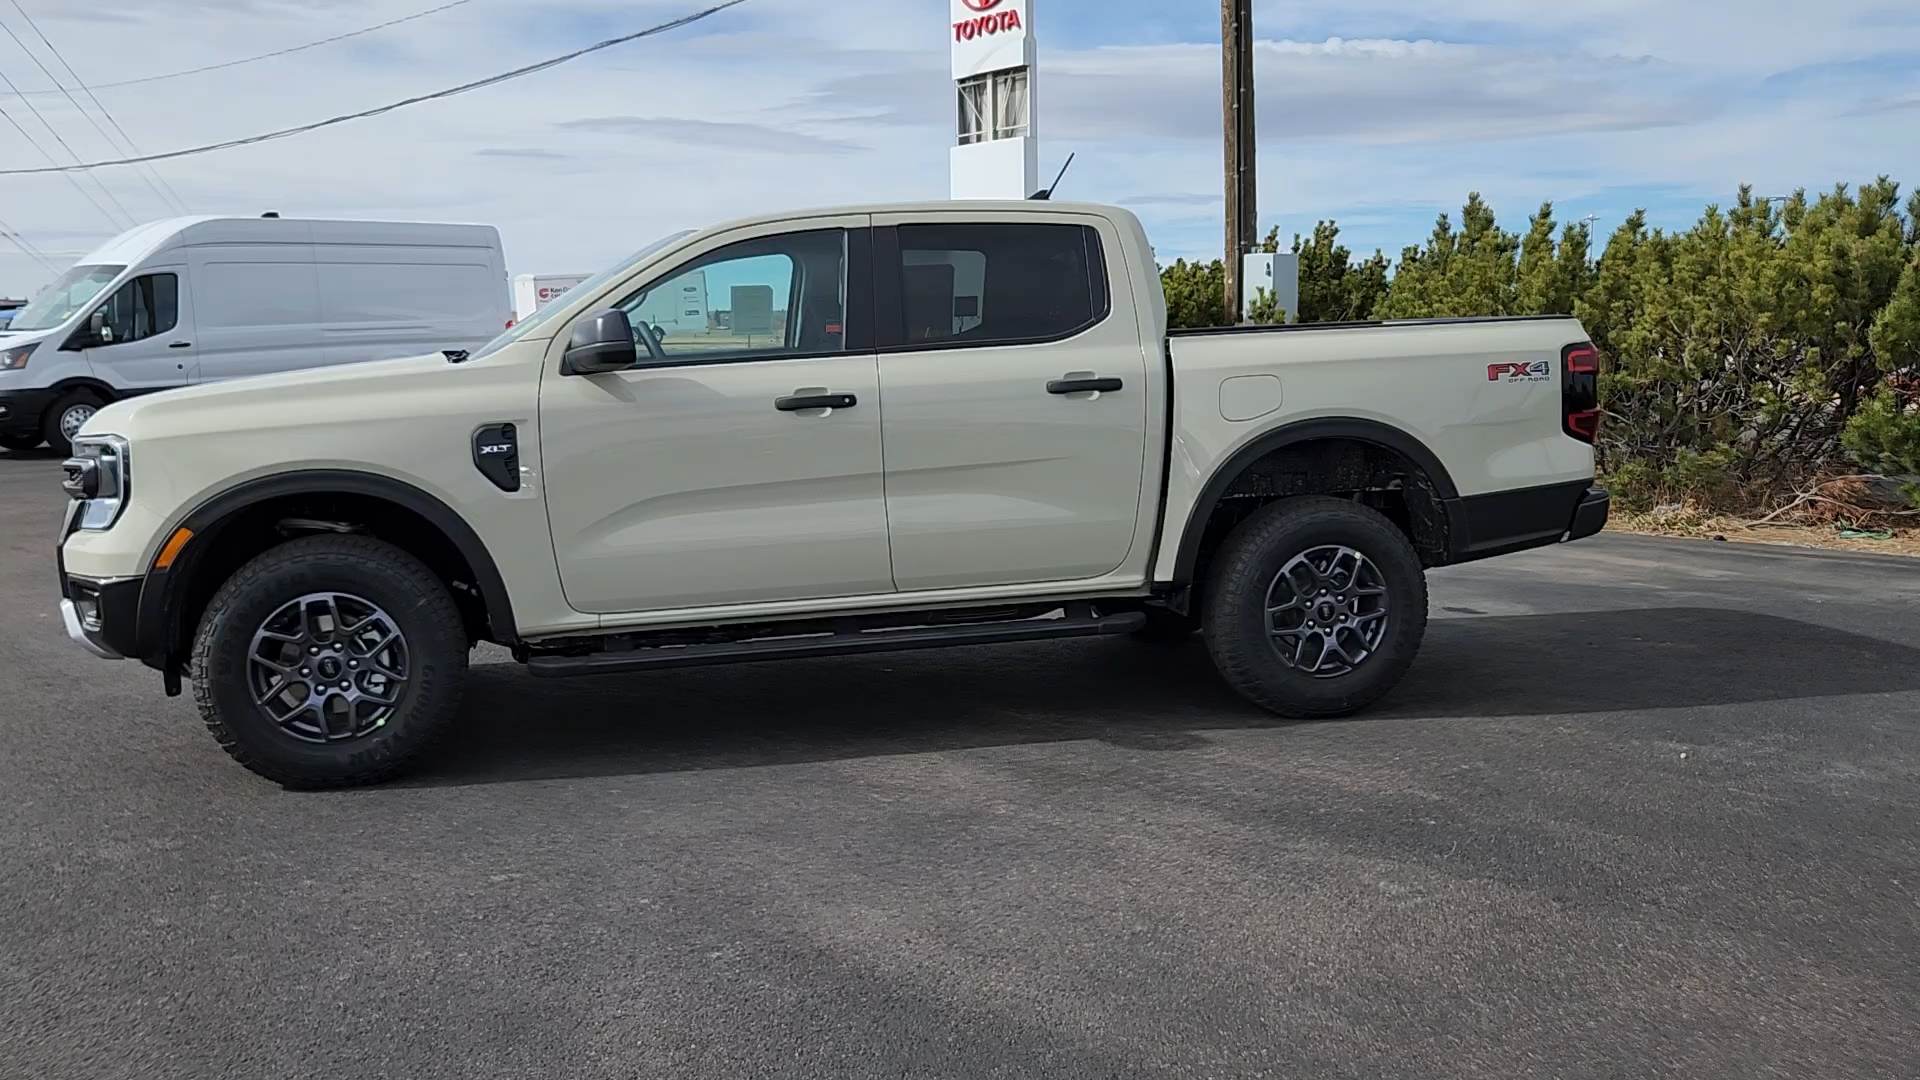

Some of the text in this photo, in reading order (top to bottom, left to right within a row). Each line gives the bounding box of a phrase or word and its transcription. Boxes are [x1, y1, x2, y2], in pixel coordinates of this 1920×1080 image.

[953, 9, 1021, 42] TOYOTA
[1487, 361, 1550, 382] FX4
[480, 444, 513, 454] XLT
